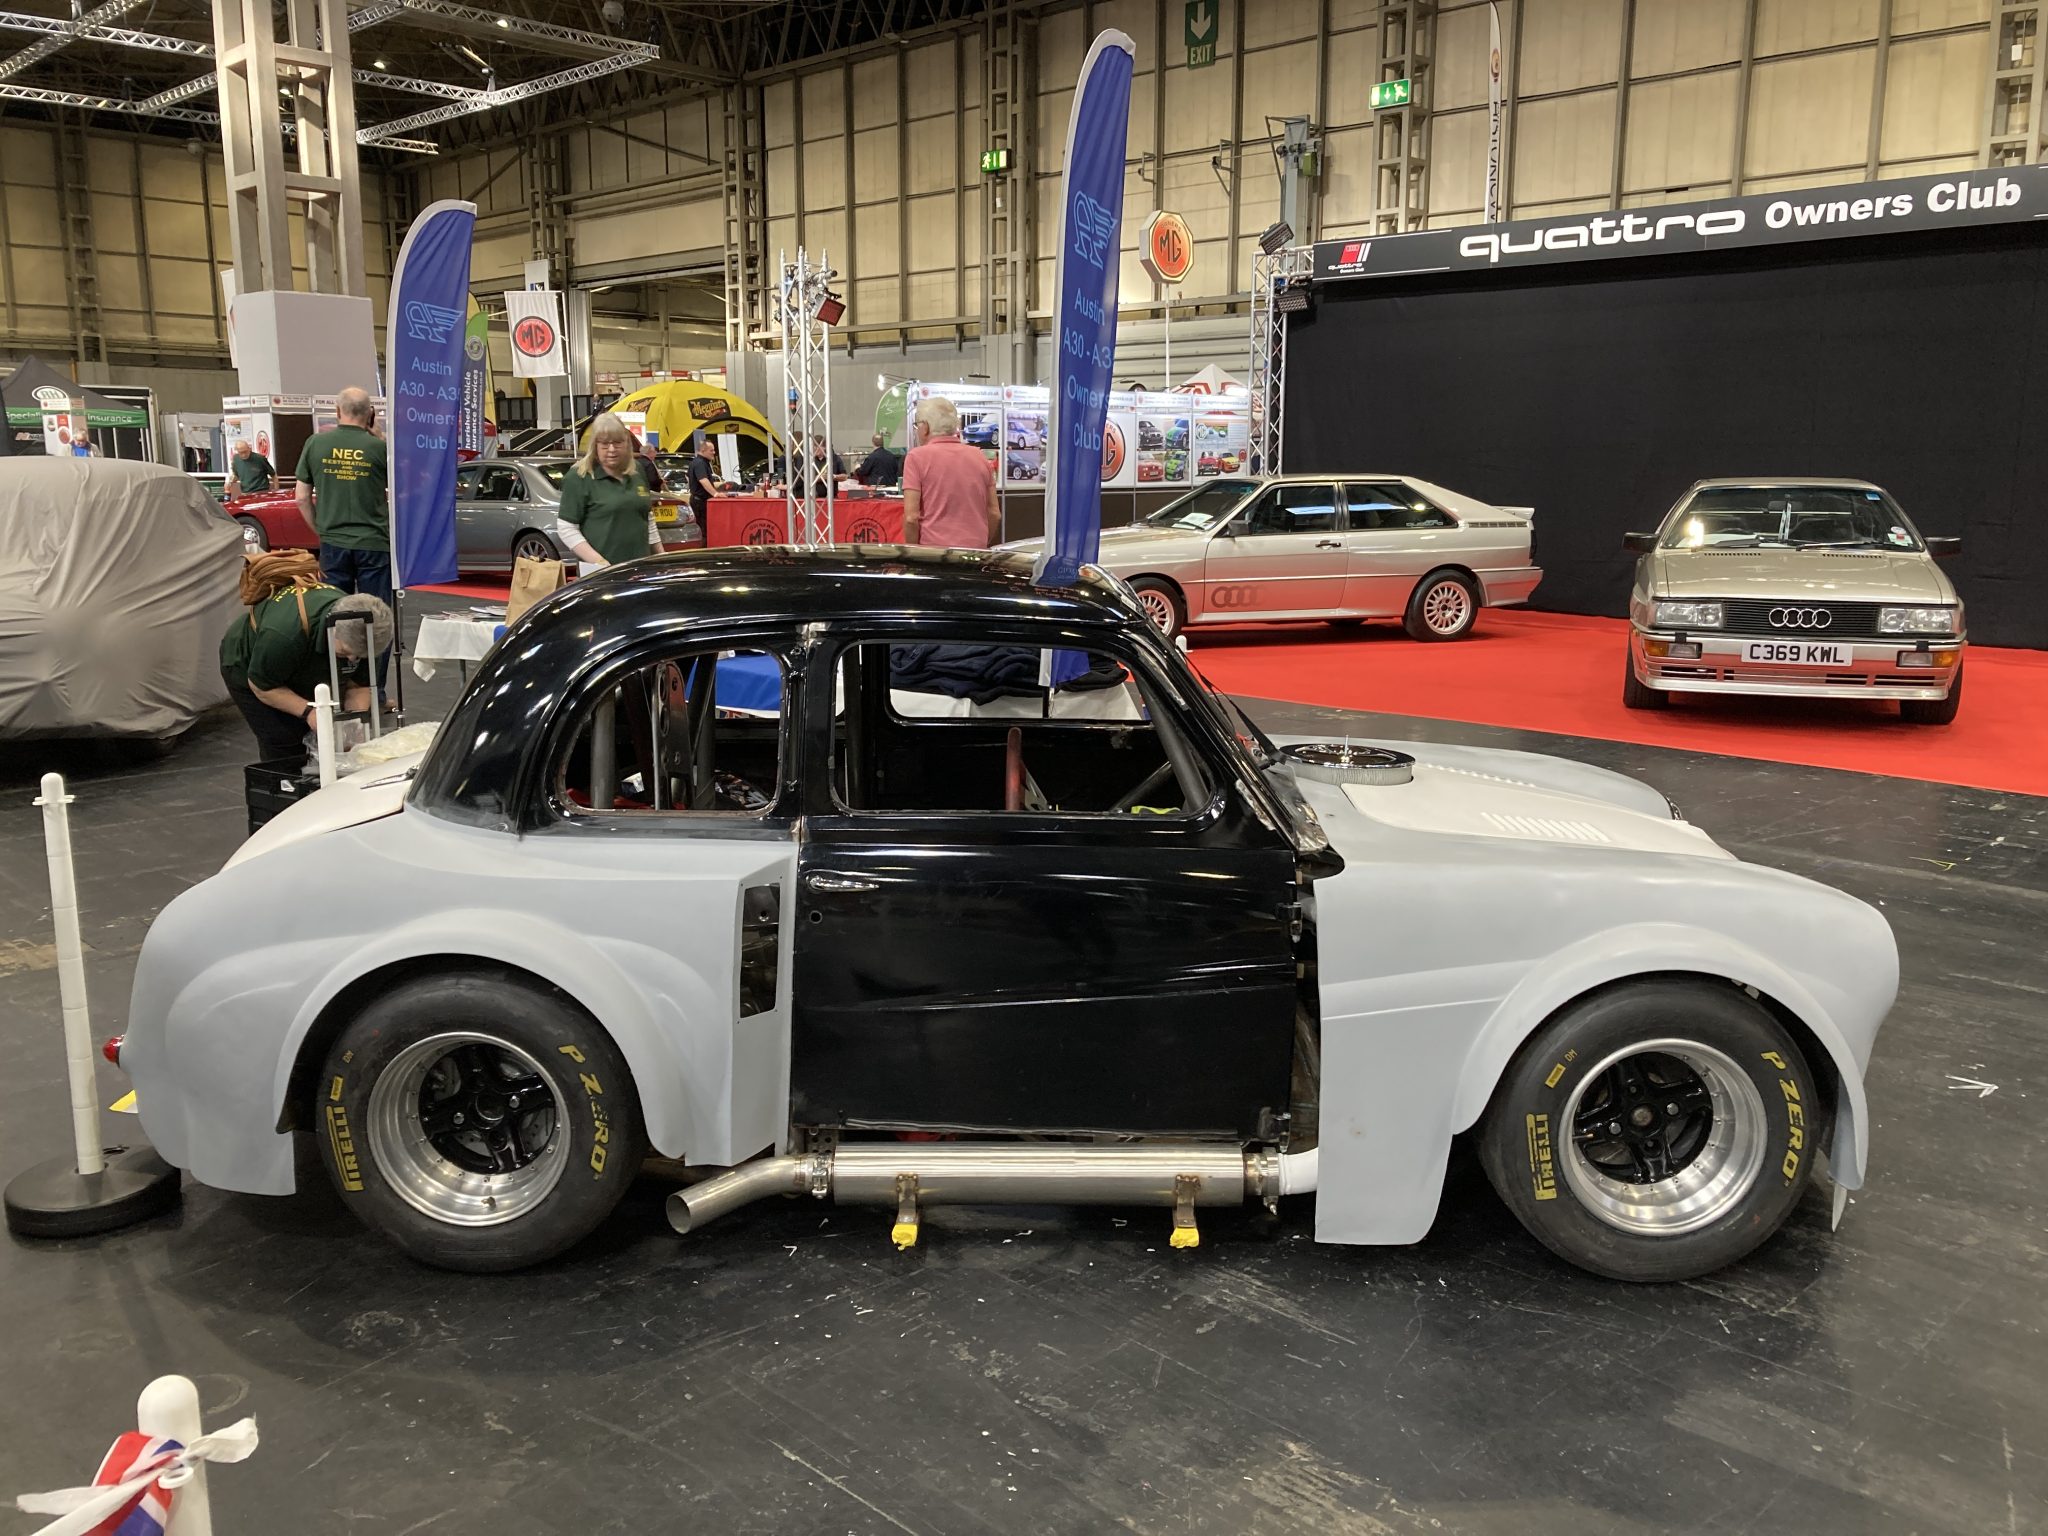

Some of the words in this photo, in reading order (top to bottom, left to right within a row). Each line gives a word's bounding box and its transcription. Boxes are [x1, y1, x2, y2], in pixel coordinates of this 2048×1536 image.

[1190, 44, 1211, 65] EXIT
[1459, 209, 1745, 262] quattro
[1765, 193, 1913, 229] Owners
[1926, 177, 2022, 213] Club
[1160, 229, 1182, 262] MG
[1074, 288, 1105, 326] Austin
[521, 323, 545, 348] MG
[1063, 327, 1084, 359] A30
[1091, 344, 1112, 369] A3
[411, 356, 452, 376] Austin
[399, 380, 424, 397] A30
[1067, 375, 1110, 410] Owners
[406, 407, 456, 425] Owners
[416, 433, 448, 450] Club
[1073, 422, 1100, 450] Club
[322, 458, 372, 467] RESTORATION
[332, 447, 364, 460] NEC
[1749, 643, 1800, 662] C369
[1806, 646, 1844, 664] KWL
[558, 1045, 586, 1063] P
[1760, 1051, 1787, 1070] P
[1779, 1079, 1804, 1179] ZERO
[326, 1105, 364, 1191] PIRELLI
[1526, 1113, 1557, 1200] PIRELLI
